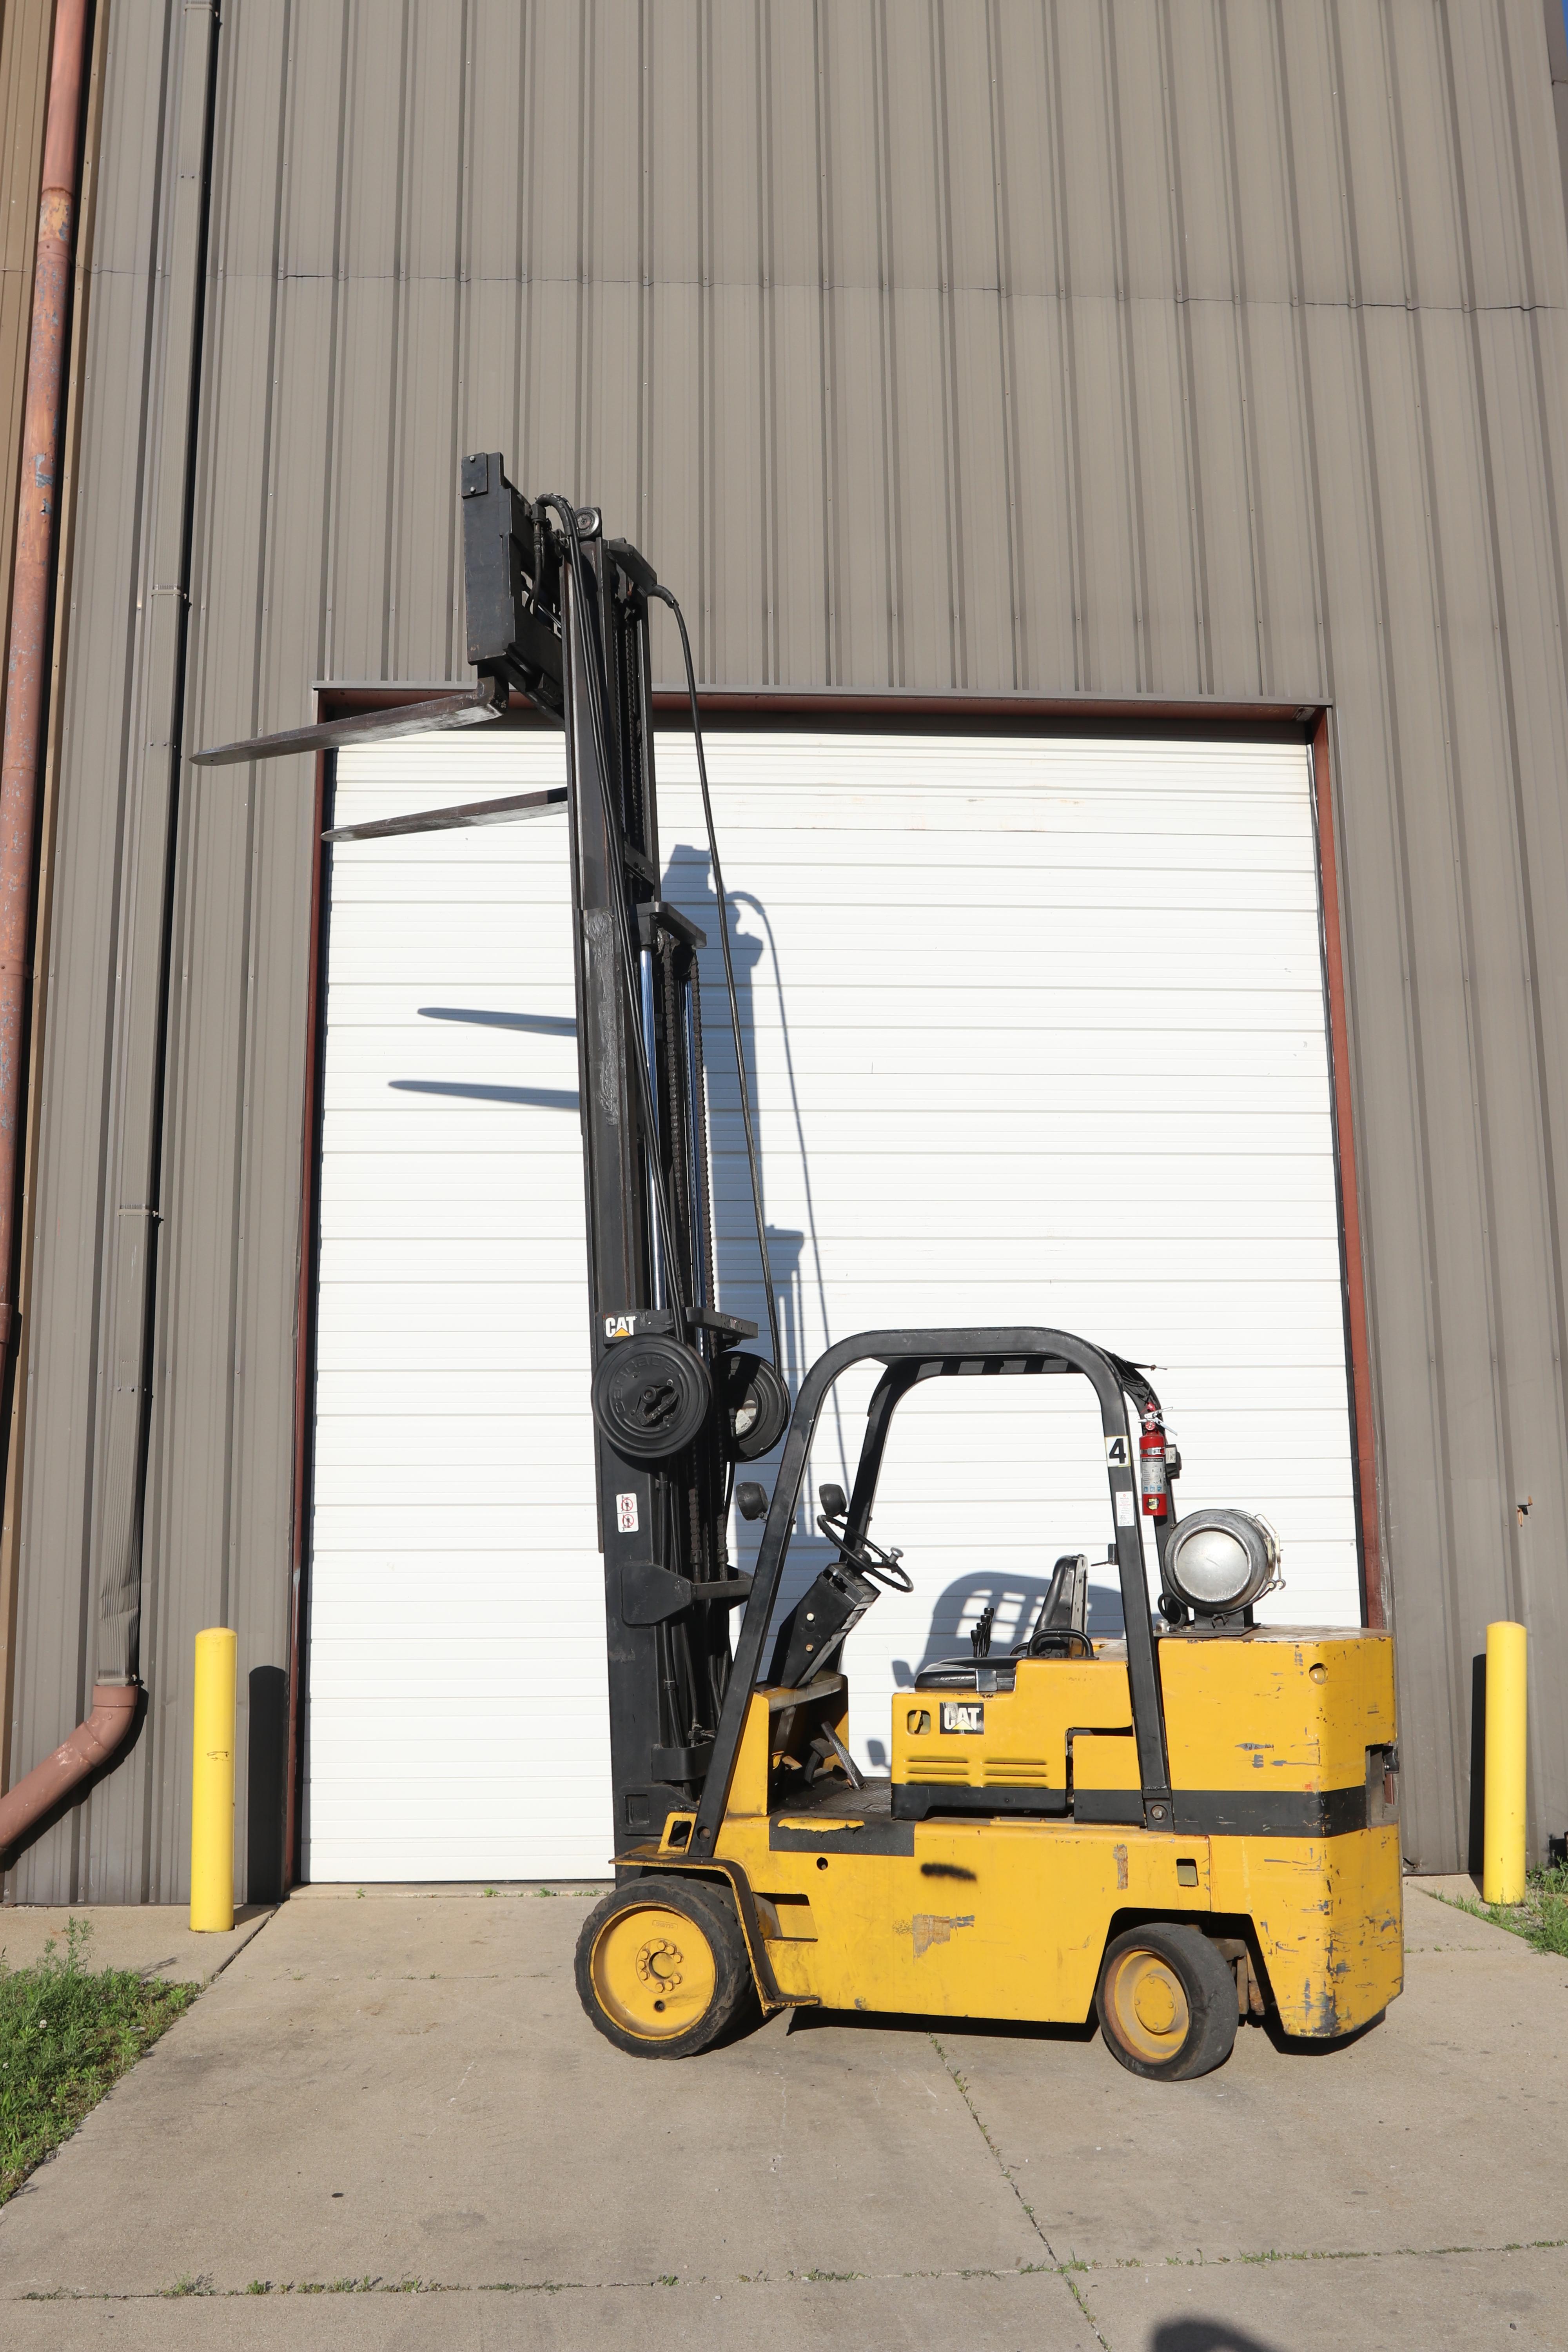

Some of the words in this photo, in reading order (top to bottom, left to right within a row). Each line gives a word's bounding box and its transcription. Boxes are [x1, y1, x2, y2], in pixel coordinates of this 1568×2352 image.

[606, 1316, 636, 1338] CAT
[1109, 1438, 1126, 1464] 4
[944, 1708, 980, 1730] CAT
